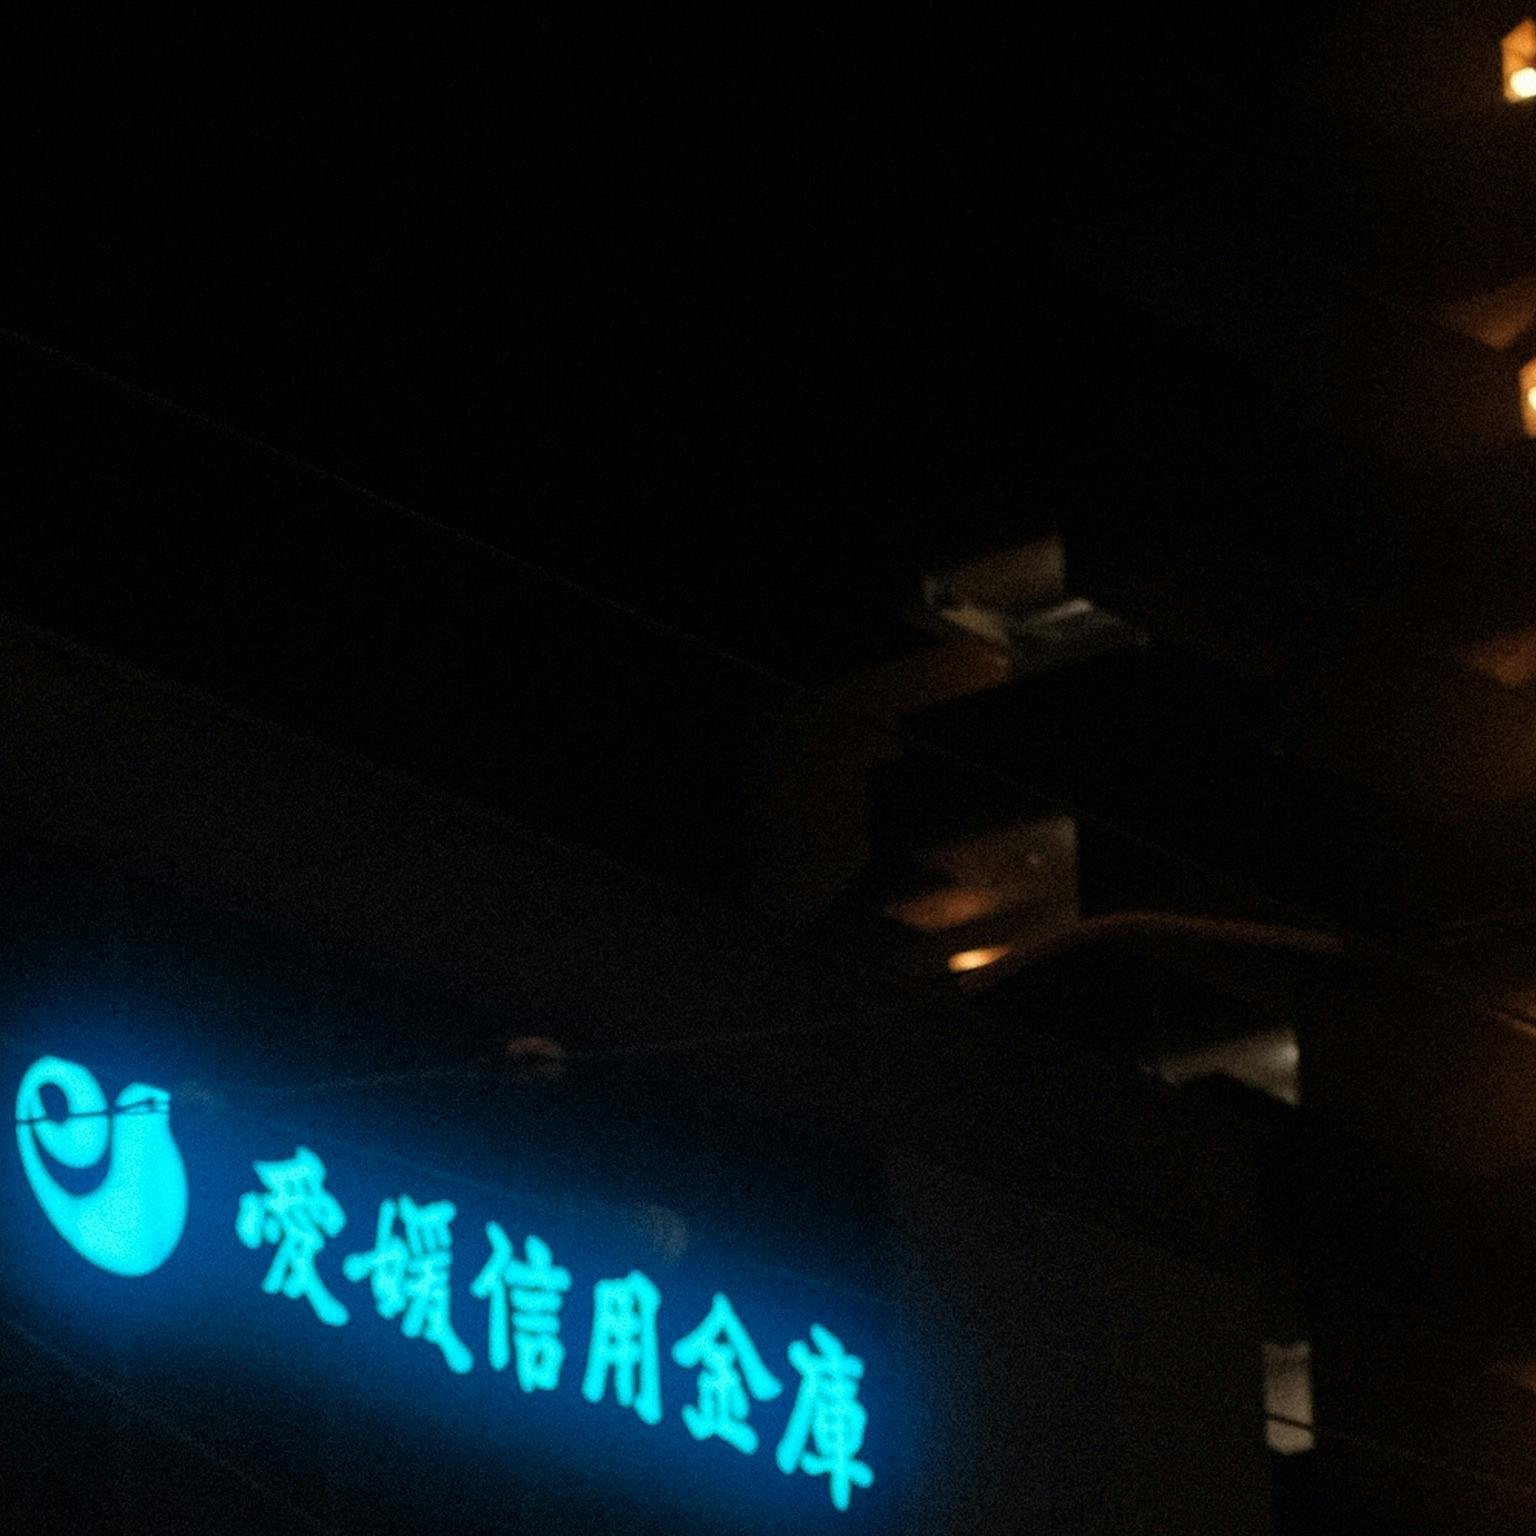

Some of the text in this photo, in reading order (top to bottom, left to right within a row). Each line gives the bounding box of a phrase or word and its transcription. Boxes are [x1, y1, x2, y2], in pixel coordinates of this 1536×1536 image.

[236, 1146, 874, 1511] 愛媛信用金庫
